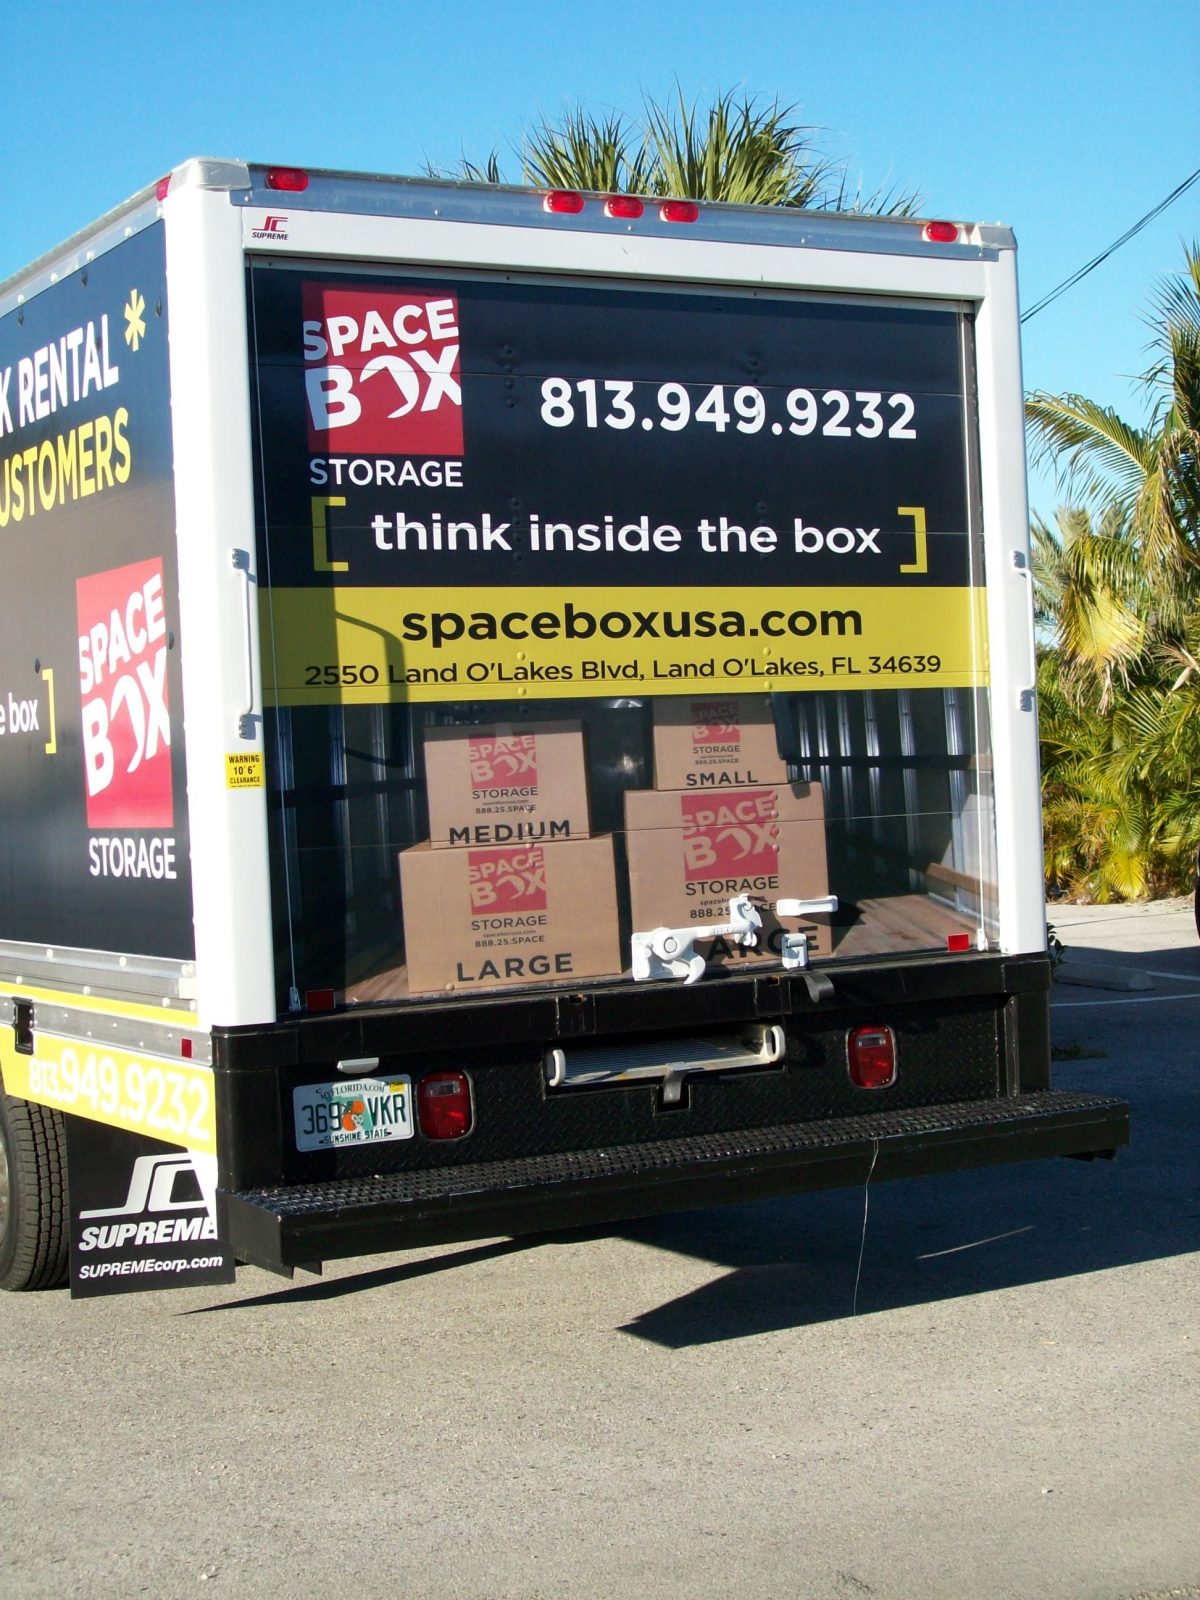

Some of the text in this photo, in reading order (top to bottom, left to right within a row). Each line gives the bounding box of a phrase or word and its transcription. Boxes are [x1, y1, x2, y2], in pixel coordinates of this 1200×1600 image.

[251, 231, 289, 241] SUPREME
[302, 298, 459, 361] SPACE
[18, 313, 119, 428] RENTAL
[304, 344, 462, 431] BOX
[540, 377, 917, 440] 813.949.9232
[0, 407, 131, 527] USTOMERS
[309, 458, 464, 488] STORAGE
[371, 512, 882, 554] think inside the box
[78, 573, 166, 695] SPACE
[402, 602, 863, 649] spaceboxusa.com
[304, 655, 941, 686] 2550 Land O'Lakes Blvd, Land O'Lakes, FL 34639
[8, 692, 40, 734] box
[81, 646, 171, 797] BOX
[228, 754, 260, 764] WARNING
[469, 735, 537, 760] SPACE
[692, 745, 741, 755] STORAGE
[229, 776, 261, 784] CLEARANCE
[470, 750, 538, 783] BOX
[685, 770, 759, 787] SMALL
[472, 786, 539, 800] STORAGE
[475, 803, 537, 815] 888.25.SPACE
[682, 795, 775, 835] SPACE
[449, 820, 571, 845] MEDIUM
[682, 820, 779, 871] BOX
[89, 837, 177, 880] STORAGE
[468, 850, 544, 879] SPACE
[471, 869, 547, 908] BOX
[685, 875, 780, 896] STORAGE
[471, 914, 548, 932] STORAGE
[475, 934, 545, 948] 888.25.SPACE
[456, 953, 574, 982] LARGE
[29, 1047, 211, 1142] 813.949.9232
[323, 1128, 389, 1145] SUNSHINE STATE
[78, 1255, 224, 1281] SUPREMEcorp.com
